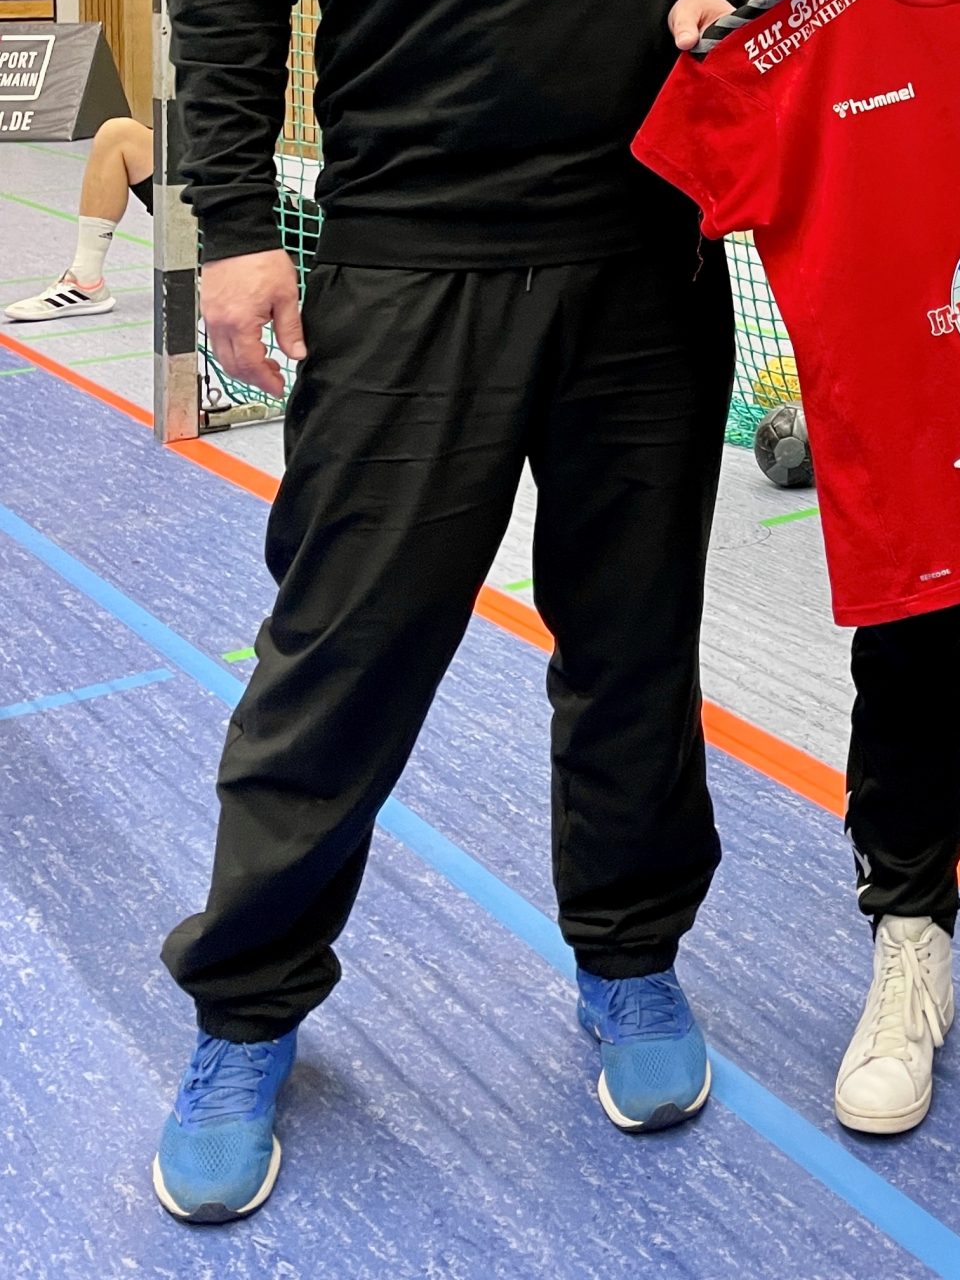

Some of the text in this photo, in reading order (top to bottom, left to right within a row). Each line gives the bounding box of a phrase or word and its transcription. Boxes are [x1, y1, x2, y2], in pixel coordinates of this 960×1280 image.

[743, 20, 784, 61] zur
[0, 51, 38, 69] PORT
[0, 72, 38, 87] MANN
[848, 82, 916, 116] hummel
[0, 111, 35, 131] .DE
